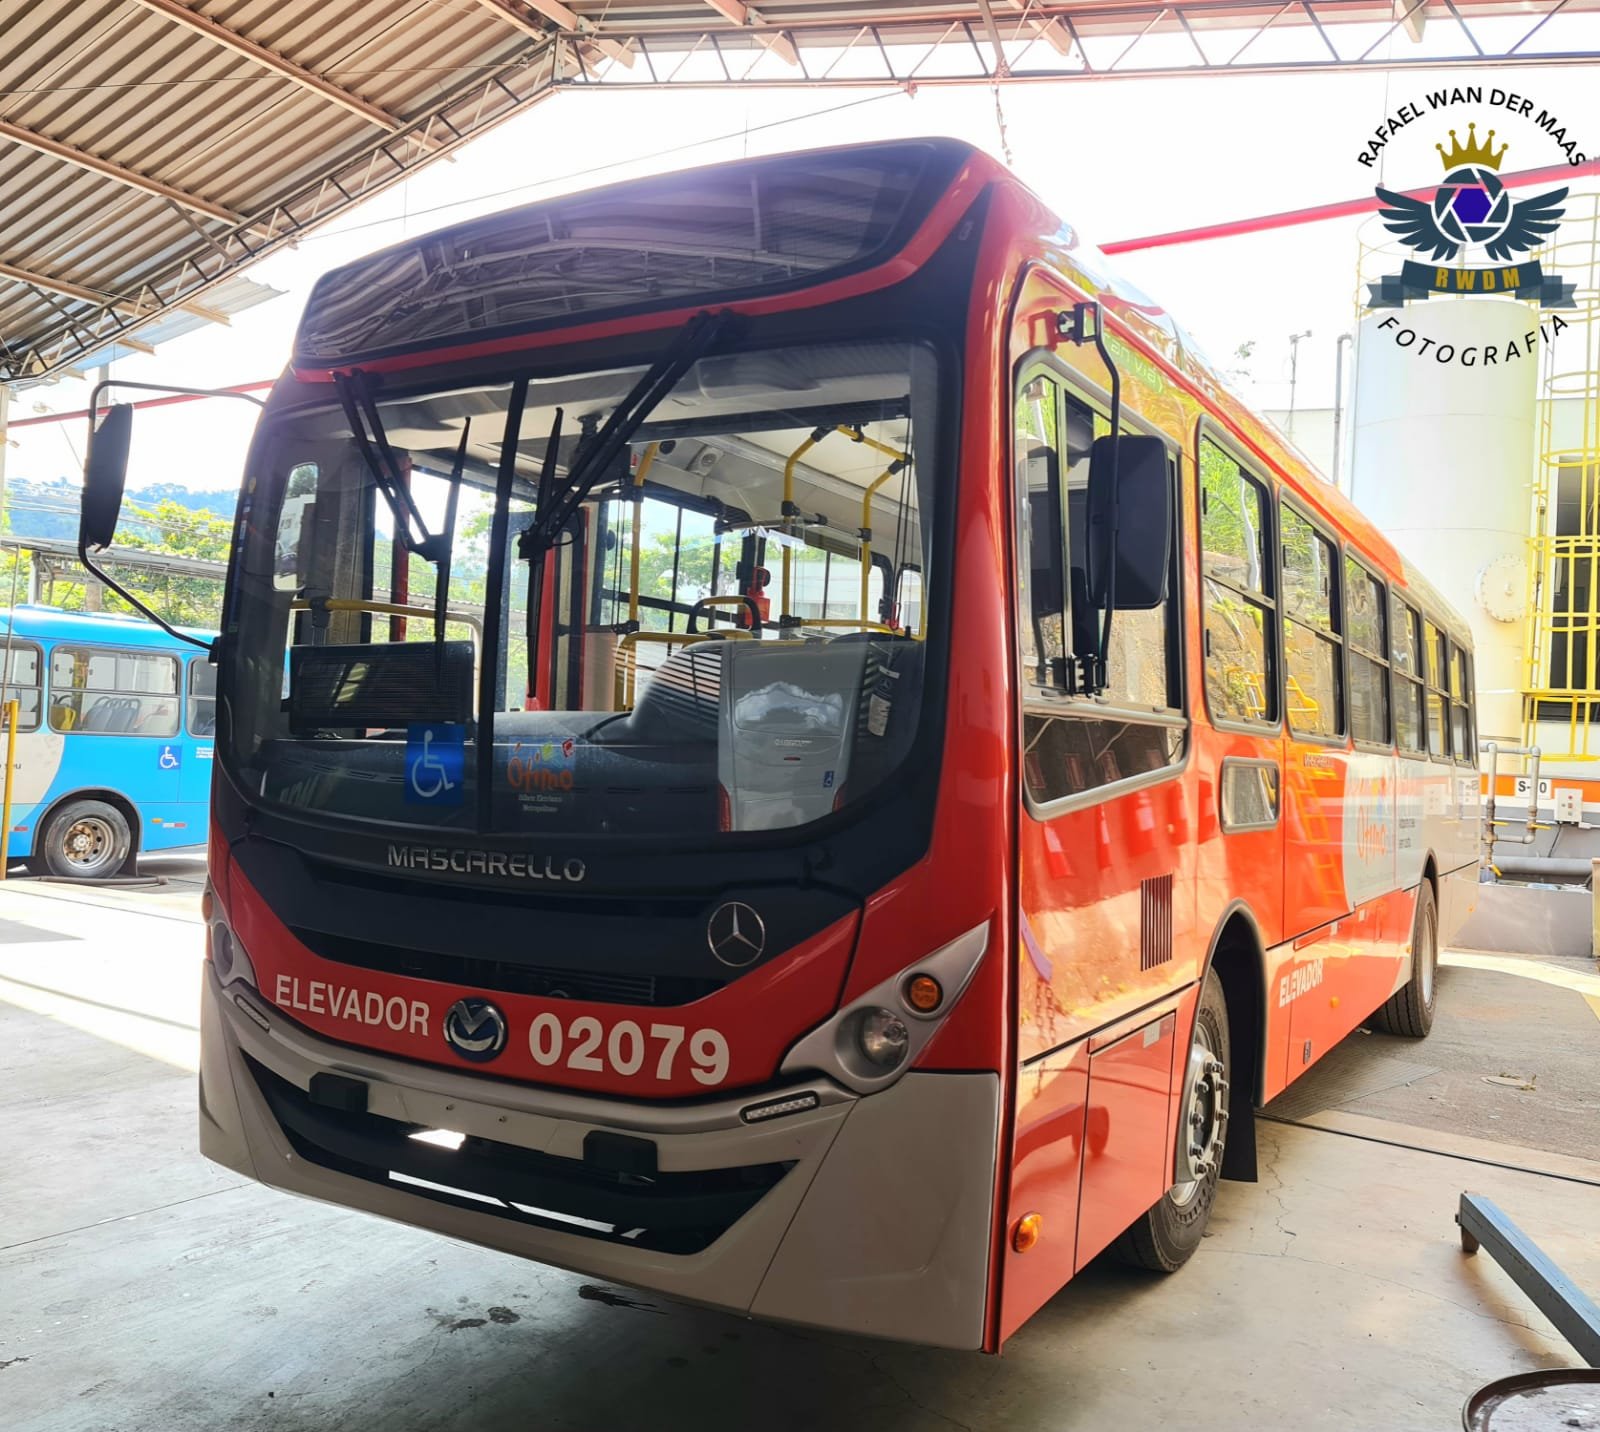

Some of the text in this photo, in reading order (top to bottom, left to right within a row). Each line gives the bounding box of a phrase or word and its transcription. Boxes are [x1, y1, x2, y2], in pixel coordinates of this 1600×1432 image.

[1518, 780, 1548, 794] S-0
[387, 844, 587, 882] MASCARELLO
[275, 974, 431, 1037] ELEVADOR
[1278, 957, 1325, 1009] ELEVADOR
[528, 1012, 731, 1086] 02079
